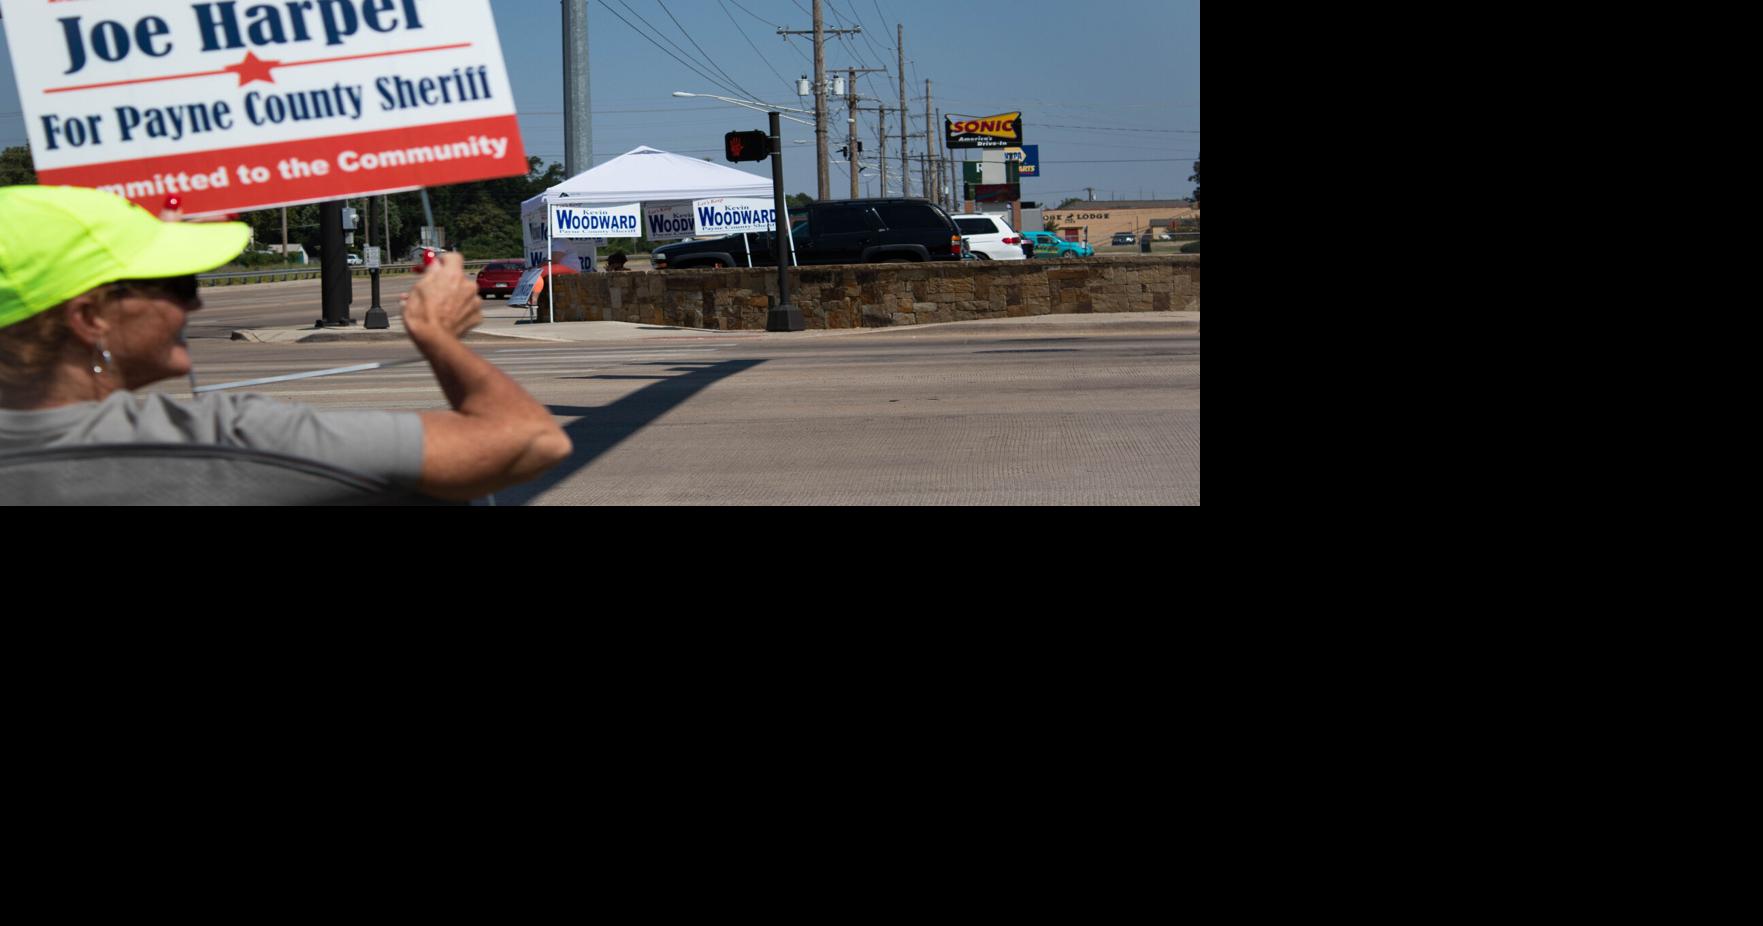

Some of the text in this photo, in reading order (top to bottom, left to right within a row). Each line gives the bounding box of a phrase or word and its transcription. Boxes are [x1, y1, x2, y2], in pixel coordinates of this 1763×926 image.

[57, 0, 424, 75] Joe Harper
[41, 65, 493, 151] For Payne County Sheriff
[953, 120, 1013, 133] SONIC
[96, 134, 508, 199] mmitted to the Community
[556, 209, 637, 230] WOODWARD
[698, 206, 776, 227] WOODWARD
